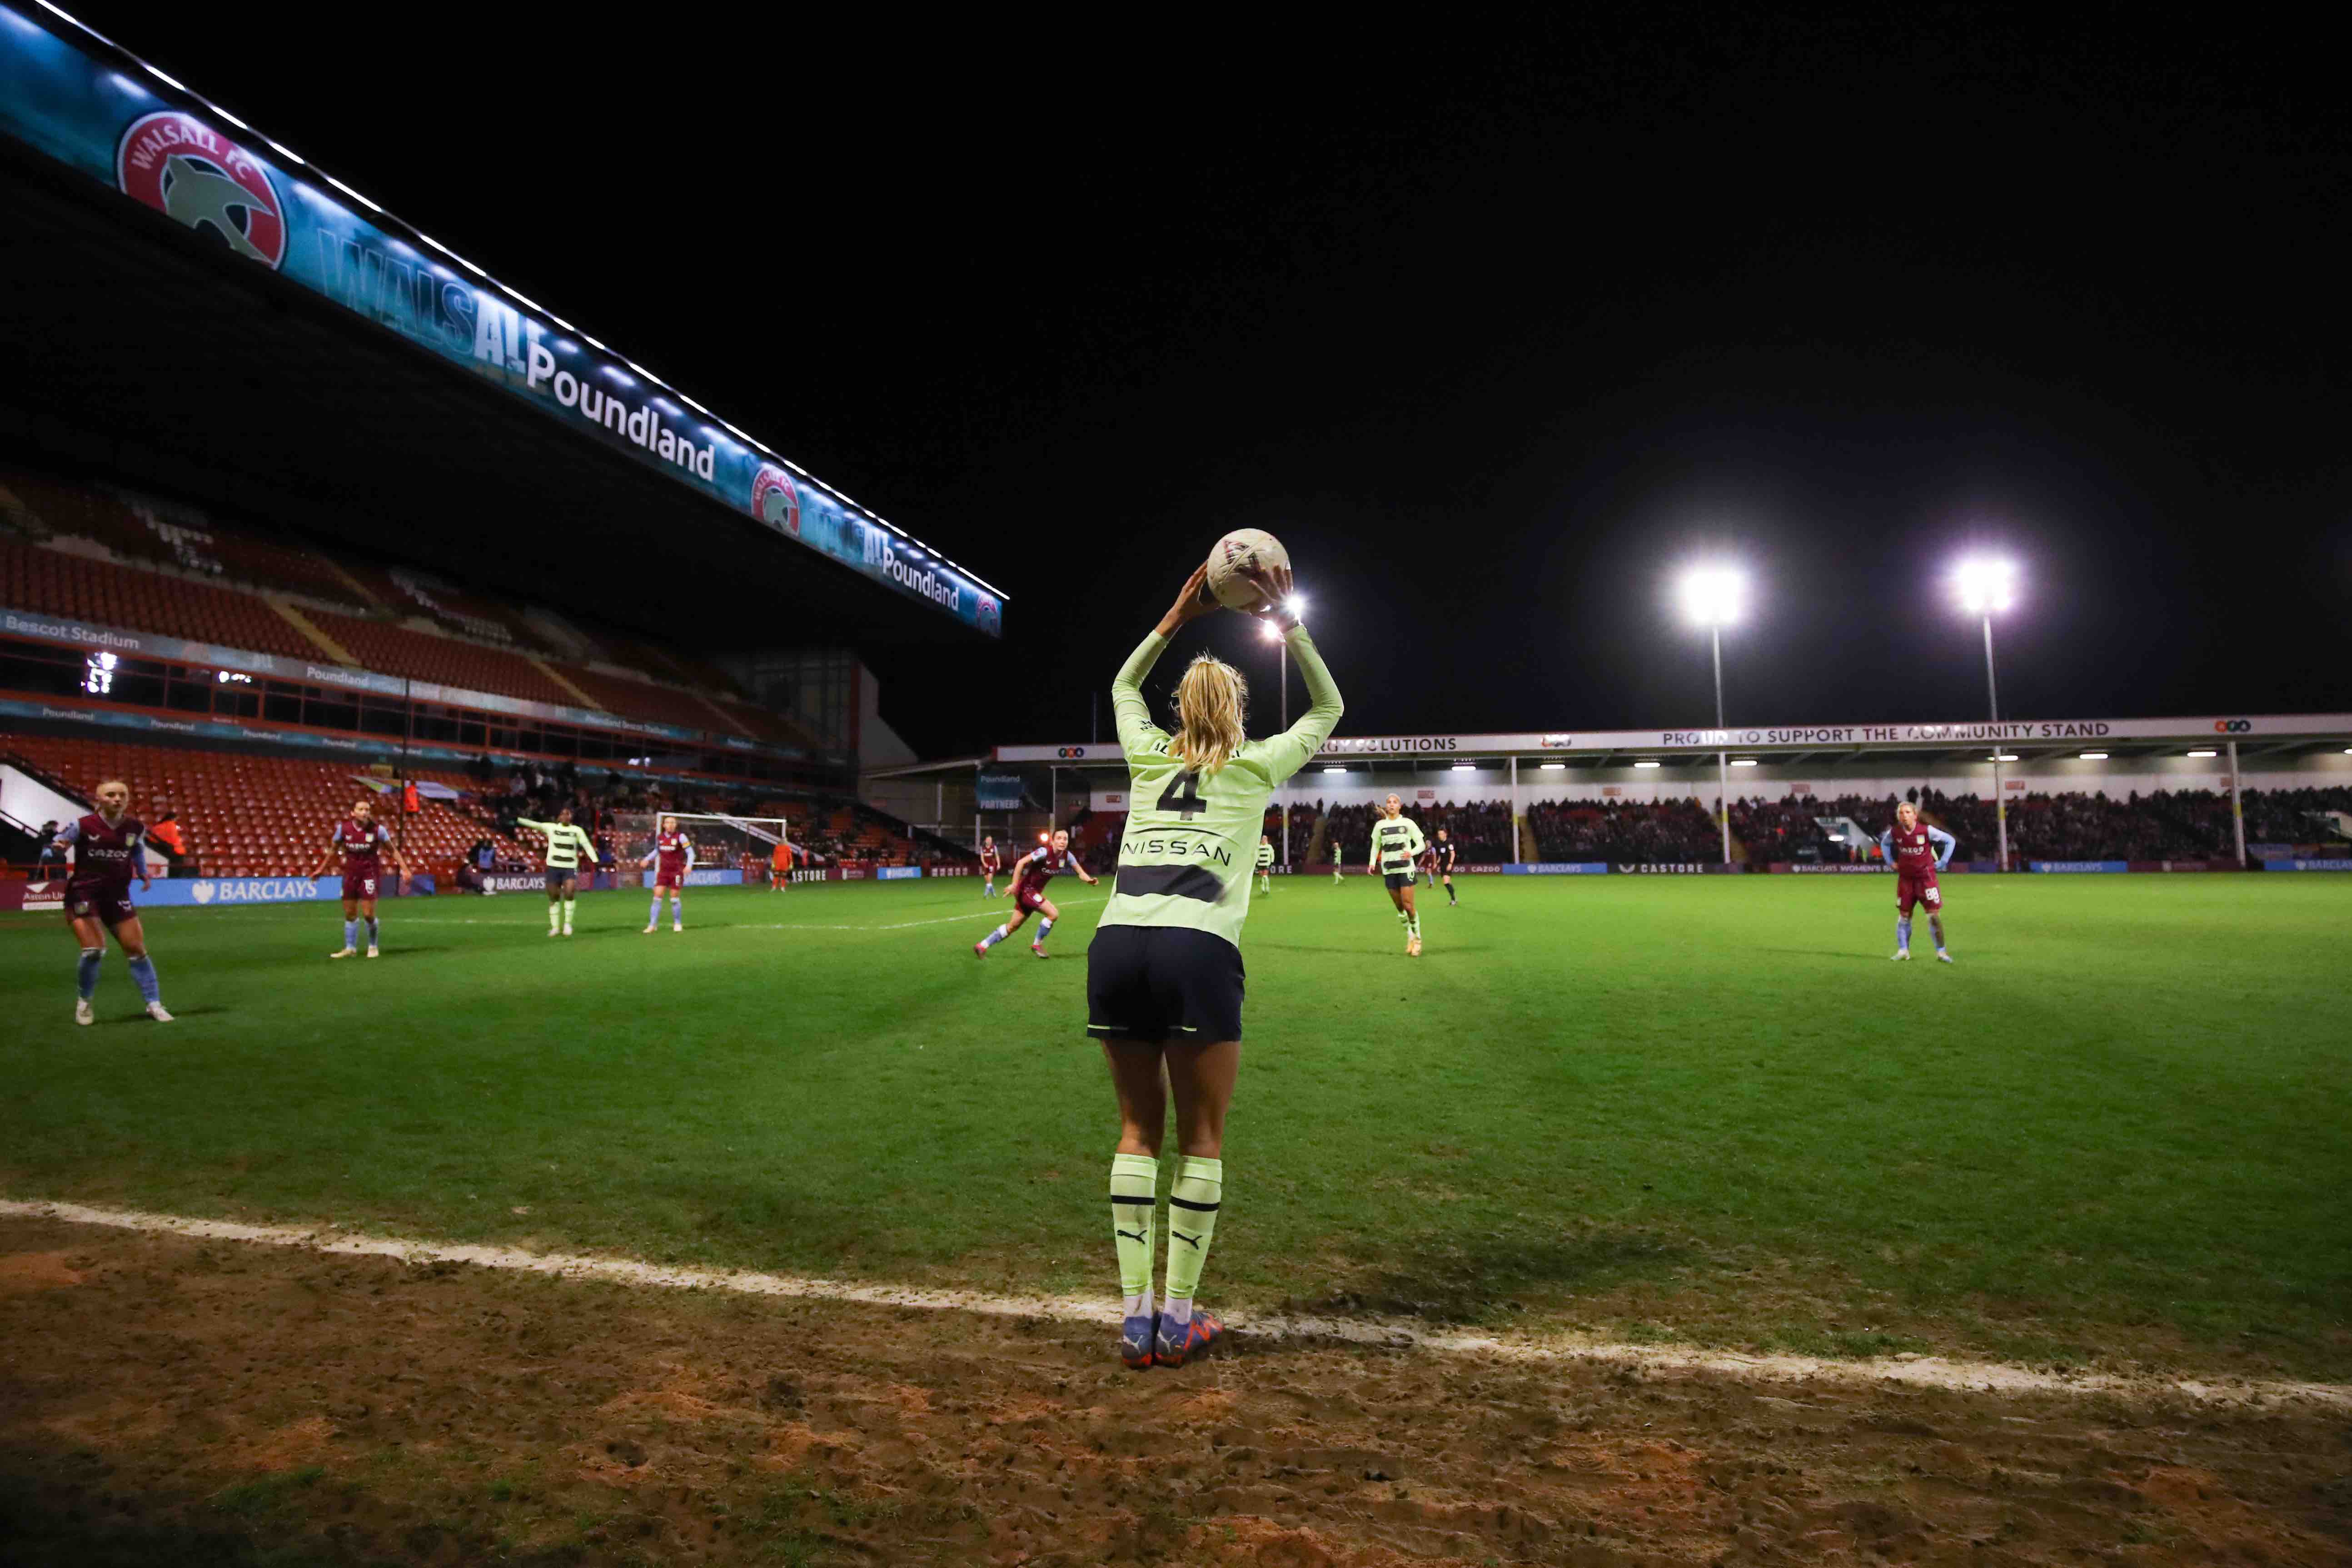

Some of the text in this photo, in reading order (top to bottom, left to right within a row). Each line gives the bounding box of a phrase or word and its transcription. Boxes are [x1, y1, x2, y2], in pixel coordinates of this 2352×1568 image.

[131, 124, 253, 179] WALSALL FC
[527, 340, 714, 482] Poundland
[882, 545, 960, 611] Poundland
[5, 615, 140, 649] Bescot Stadium
[307, 666, 369, 687] Poundland
[1768, 728, 1854, 743] SUPPORT
[1864, 727, 1898, 741] THE
[2042, 723, 2110, 737] STAND
[1156, 770, 1207, 821] 4
[1121, 840, 1231, 866] NISSAN
[1641, 864, 1704, 873] CASTORE
[219, 880, 317, 901] BARCLAYS
[497, 877, 545, 890] BARCLAYS
